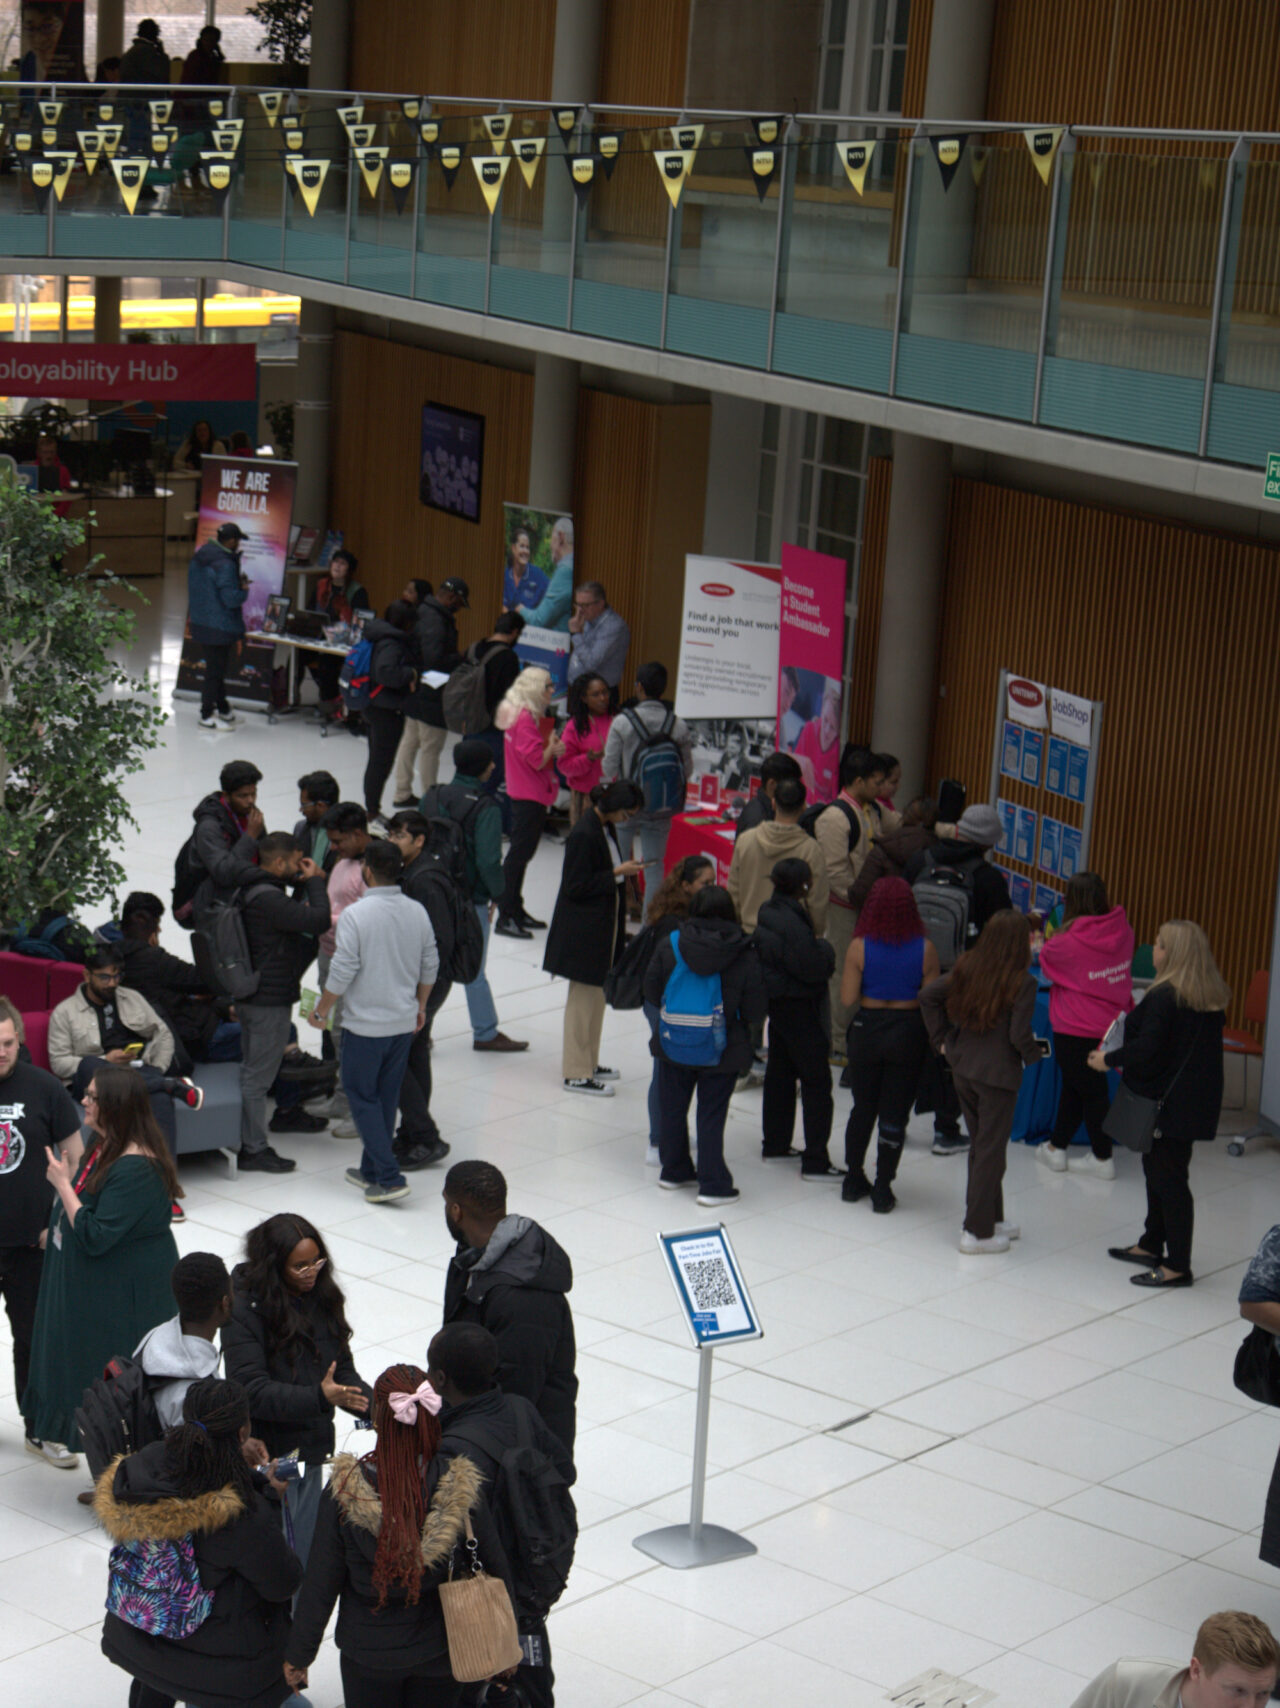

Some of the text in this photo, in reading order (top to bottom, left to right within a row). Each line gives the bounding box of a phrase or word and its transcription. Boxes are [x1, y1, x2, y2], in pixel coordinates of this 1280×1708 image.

[128, 360, 177, 382] Hub
[220, 469, 271, 492] WE ARE
[1269, 461, 1280, 478] Fi
[1267, 480, 1280, 495] ex
[217, 491, 269, 514] GORILLA.
[784, 576, 814, 599] Become
[789, 594, 820, 618] Student
[687, 625, 739, 638] around you
[688, 611, 707, 622] Find
[717, 614, 733, 626] job
[734, 617, 753, 627] that
[756, 621, 780, 631] work
[783, 612, 830, 638] Ambassador
[1012, 685, 1038, 702] UNITEMPS
[1053, 699, 1088, 725] JobShop
[1107, 973, 1126, 985] Team
